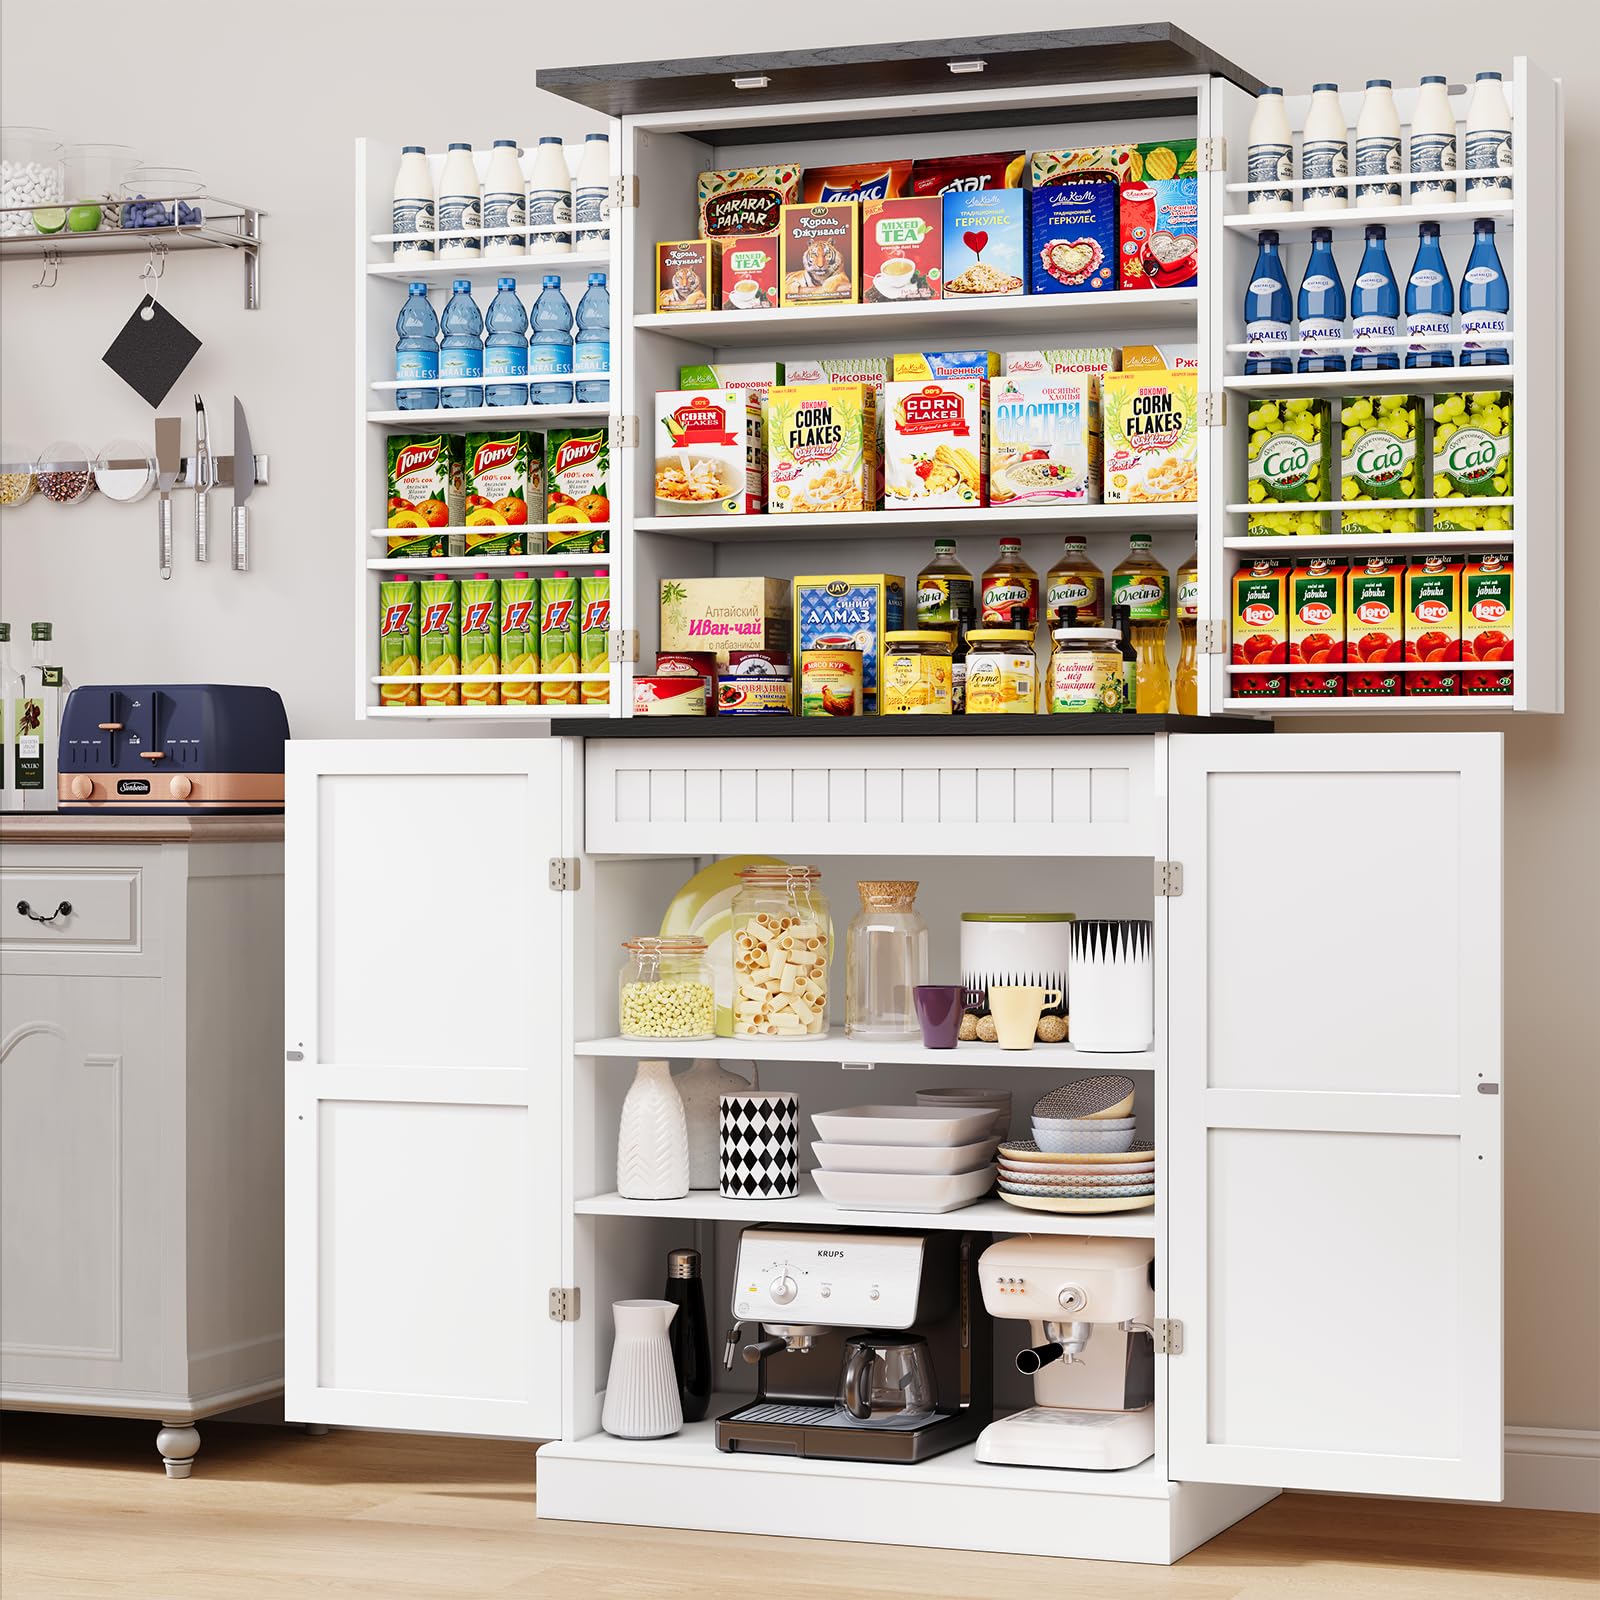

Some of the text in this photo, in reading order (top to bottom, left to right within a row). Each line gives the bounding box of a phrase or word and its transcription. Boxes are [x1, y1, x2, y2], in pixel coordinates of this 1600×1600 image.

[715, 196, 775, 217] KARARAY
[717, 212, 768, 229] PAAPAR
[881, 220, 919, 231] MIXED
[954, 215, 1011, 228] ГЕРКУЛЕС
[1048, 214, 1097, 226] ГЕРКУЛЕС
[881, 229, 918, 243] TEA
[735, 259, 761, 269] TEA
[936, 367, 984, 376] Пшенные
[1054, 363, 1108, 374] Рисовые
[831, 372, 883, 384] Рисовые
[725, 381, 773, 389] Гороховые
[1139, 388, 1167, 396] BOKOMO
[801, 401, 828, 410] BOKOMO
[907, 399, 958, 411] CORN
[1133, 394, 1172, 416] CORN
[681, 412, 717, 421] CORN
[795, 407, 833, 429] CORN
[907, 410, 958, 421] FLAKES
[681, 419, 719, 427] FLAKES
[1127, 412, 1183, 437] FLAKES
[790, 425, 842, 449] FLAKES
[1131, 428, 1178, 448] Original
[793, 441, 838, 459] Original
[1449, 440, 1497, 472] Сад
[1263, 447, 1309, 477] Сад
[1357, 443, 1403, 474] Сад
[1112, 490, 1121, 499] kg
[776, 500, 785, 509] kg
[829, 584, 847, 593] JAY
[1361, 588, 1386, 600] jabuka
[1419, 588, 1444, 599] jabuka
[1476, 587, 1502, 598] jabuka
[919, 593, 941, 605] ейна
[984, 590, 1027, 606] Олейна
[1048, 588, 1088, 603] Олейна
[1117, 589, 1160, 604] Олейна
[1246, 590, 1271, 602] jabuka
[1303, 590, 1328, 601] jabuka
[705, 604, 759, 618] Алтайский
[807, 610, 870, 624] АЛМАЗ
[688, 618, 762, 636] Иван-чай
[714, 641, 761, 650] лабазником
[808, 662, 829, 670] МЯСО
[972, 673, 999, 684] Ferma
[120, 782, 149, 793] Sunbeam
[818, 1250, 845, 1258] KRUPS
